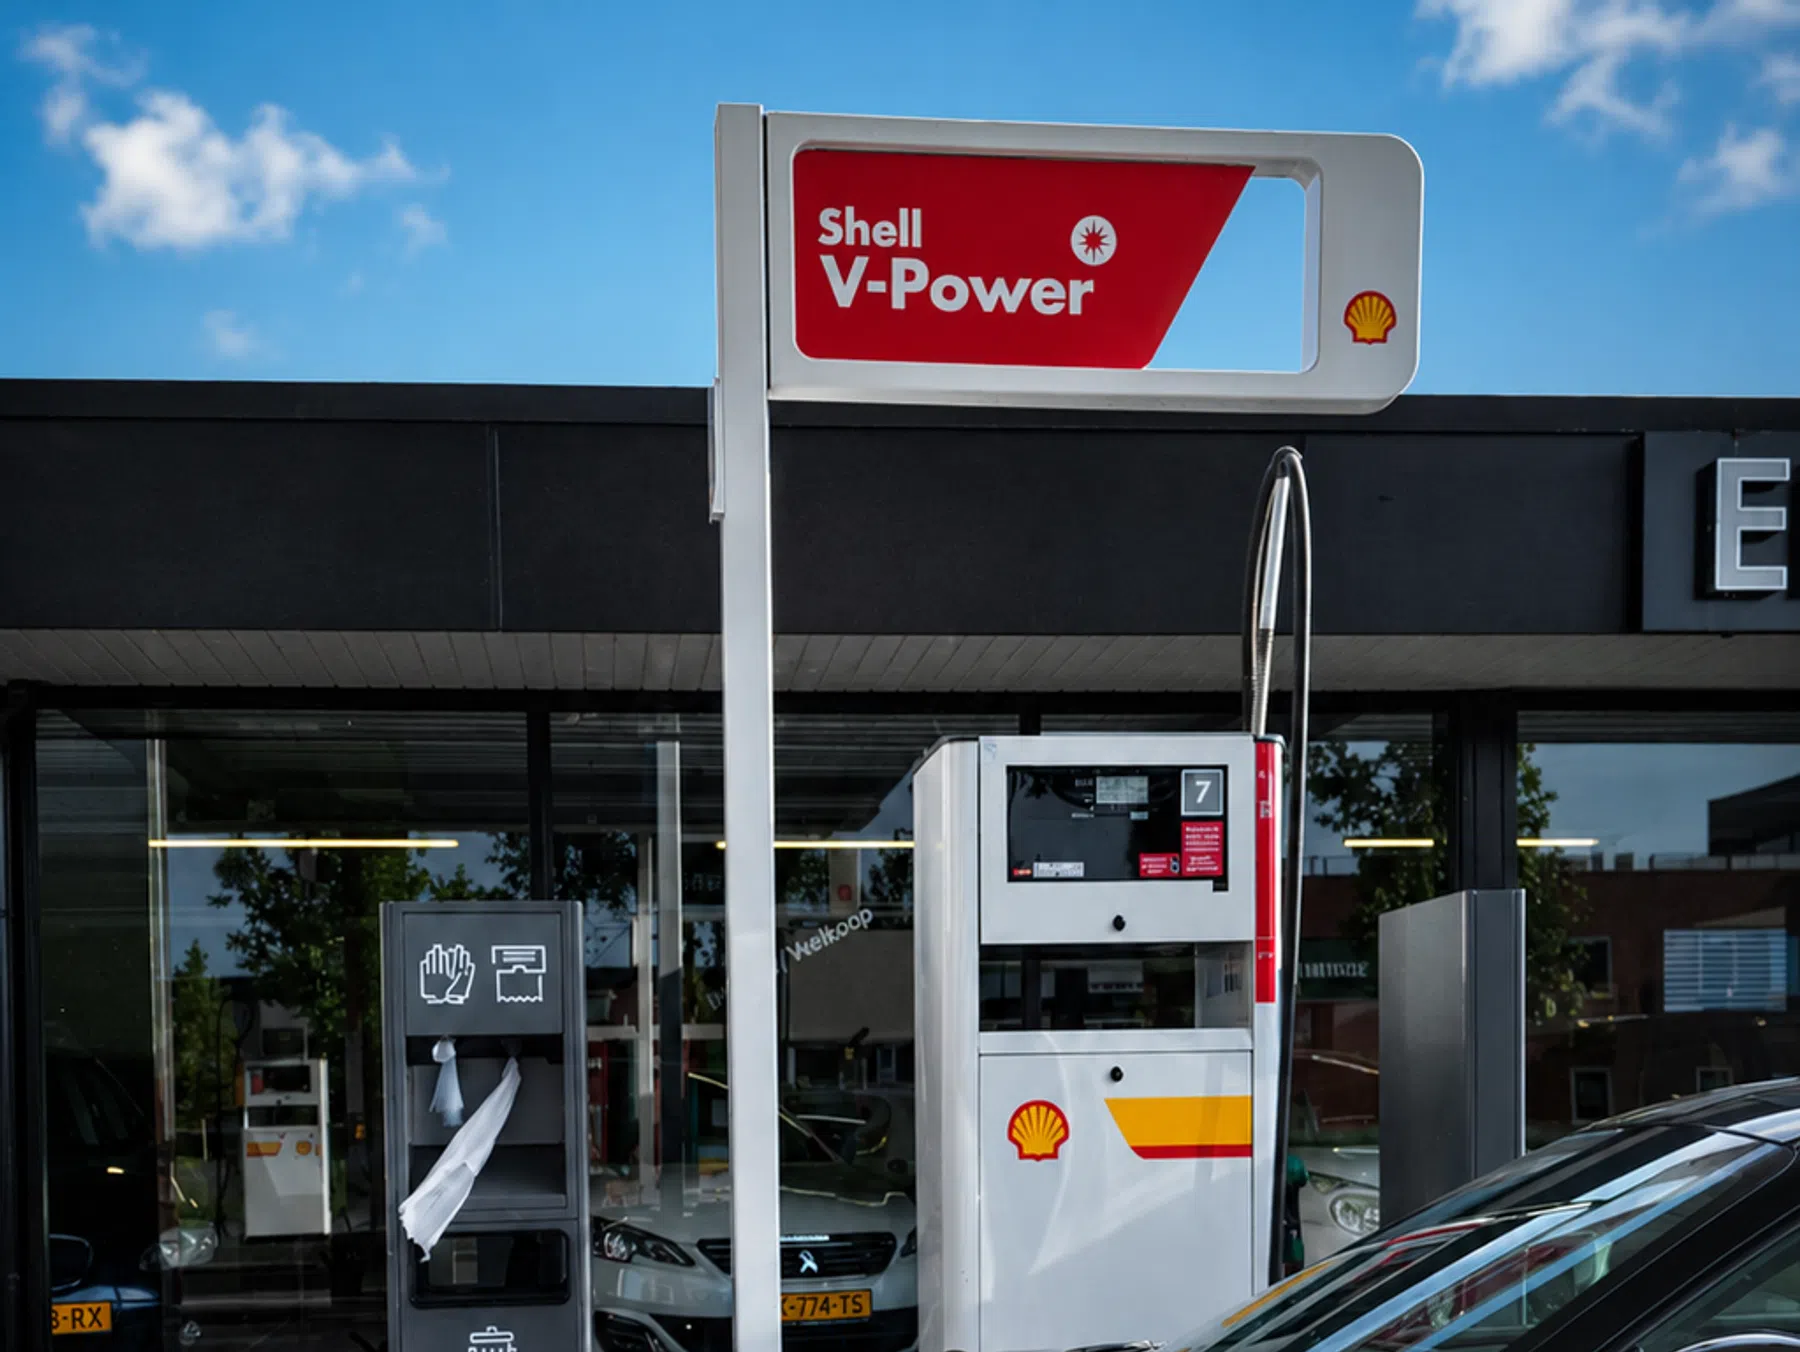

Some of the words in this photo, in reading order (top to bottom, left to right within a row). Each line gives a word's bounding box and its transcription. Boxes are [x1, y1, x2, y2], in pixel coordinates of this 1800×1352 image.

[819, 208, 922, 249] Shell
[820, 255, 1094, 314] V-Power
[1716, 458, 1790, 590] E
[1195, 780, 1211, 804] 7
